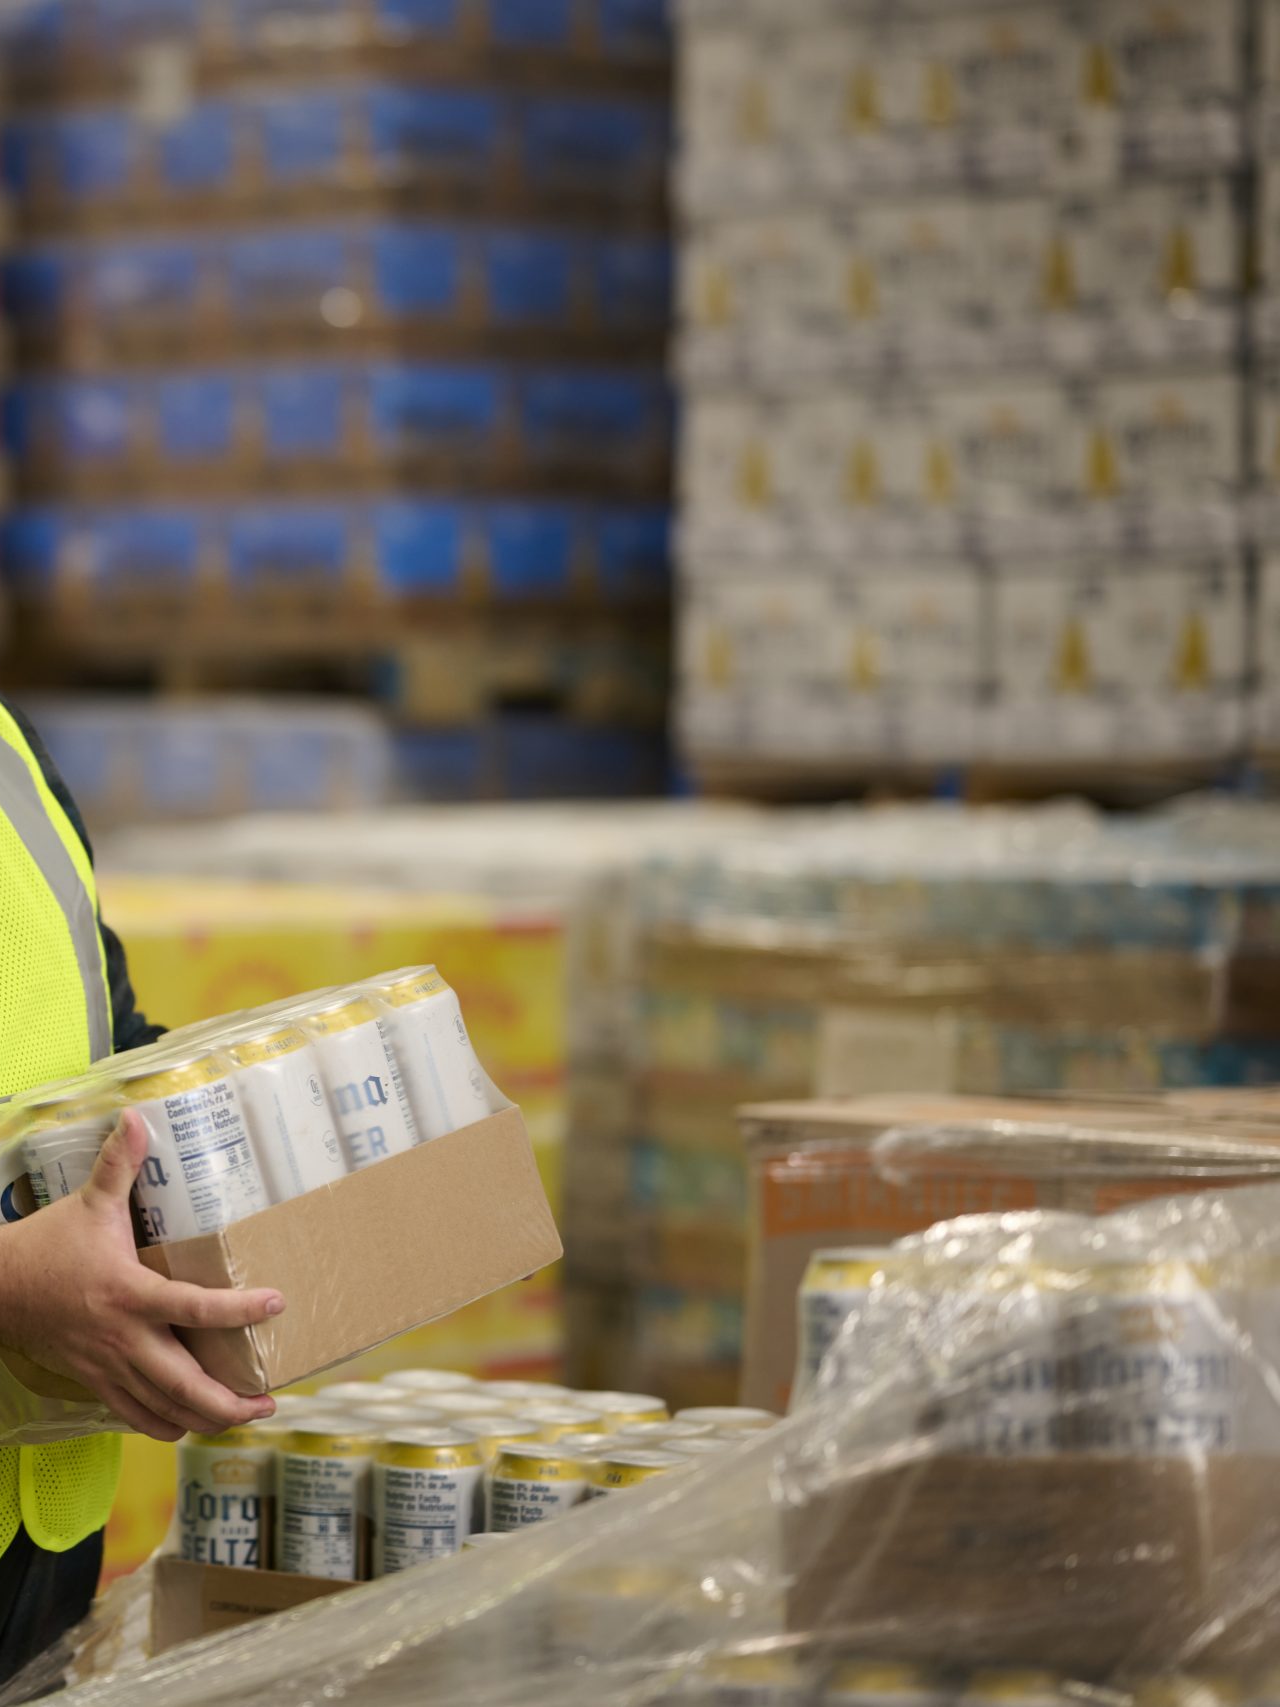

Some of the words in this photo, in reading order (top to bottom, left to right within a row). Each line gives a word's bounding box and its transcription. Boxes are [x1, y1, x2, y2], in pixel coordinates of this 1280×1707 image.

[211, 1107, 231, 1121] Facts
[174, 1129, 200, 1143] Datos
[347, 1125, 389, 1163] ER
